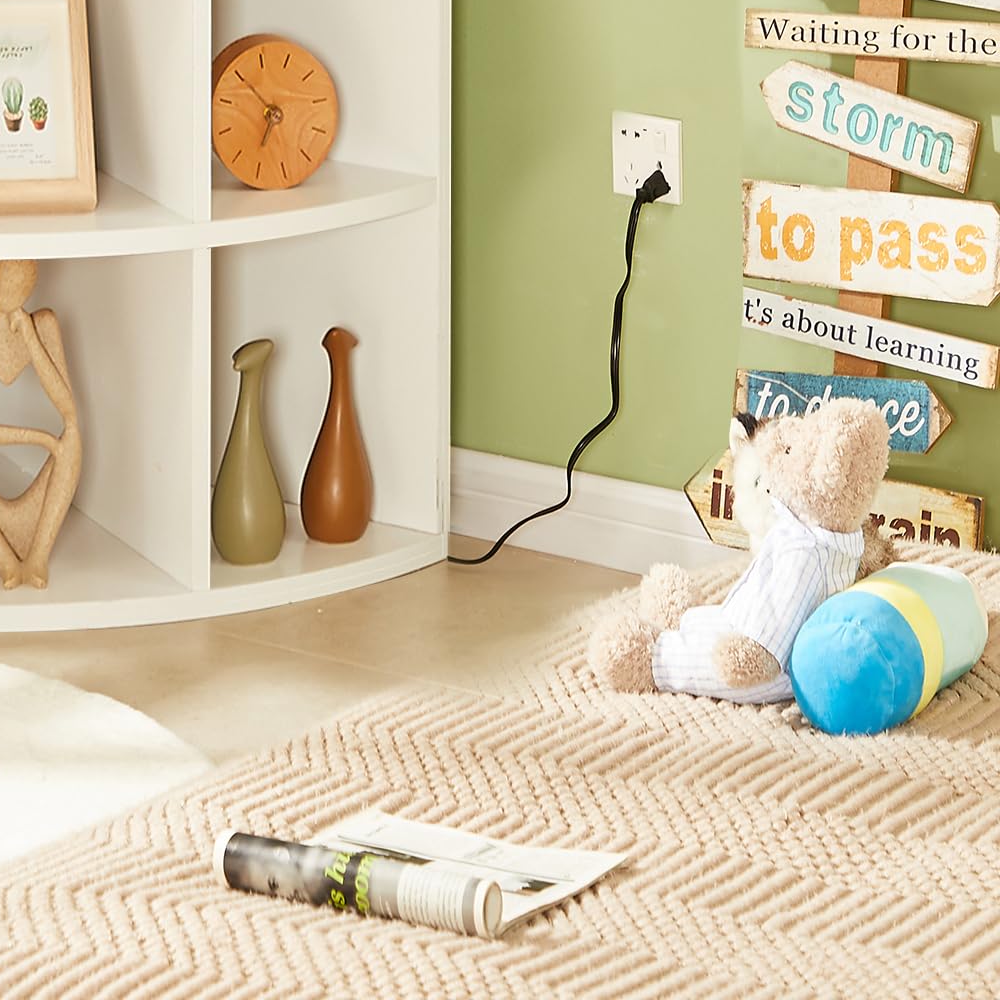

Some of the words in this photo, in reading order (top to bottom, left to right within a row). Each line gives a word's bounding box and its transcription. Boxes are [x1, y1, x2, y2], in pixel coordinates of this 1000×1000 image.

[758, 17, 880, 53] Waiting
[890, 24, 937, 52] for
[945, 28, 998, 56] the
[785, 81, 955, 175] storm
[756, 195, 816, 262] to
[839, 214, 988, 281] pass
[781, 308, 857, 346] about
[864, 320, 981, 381] learning
